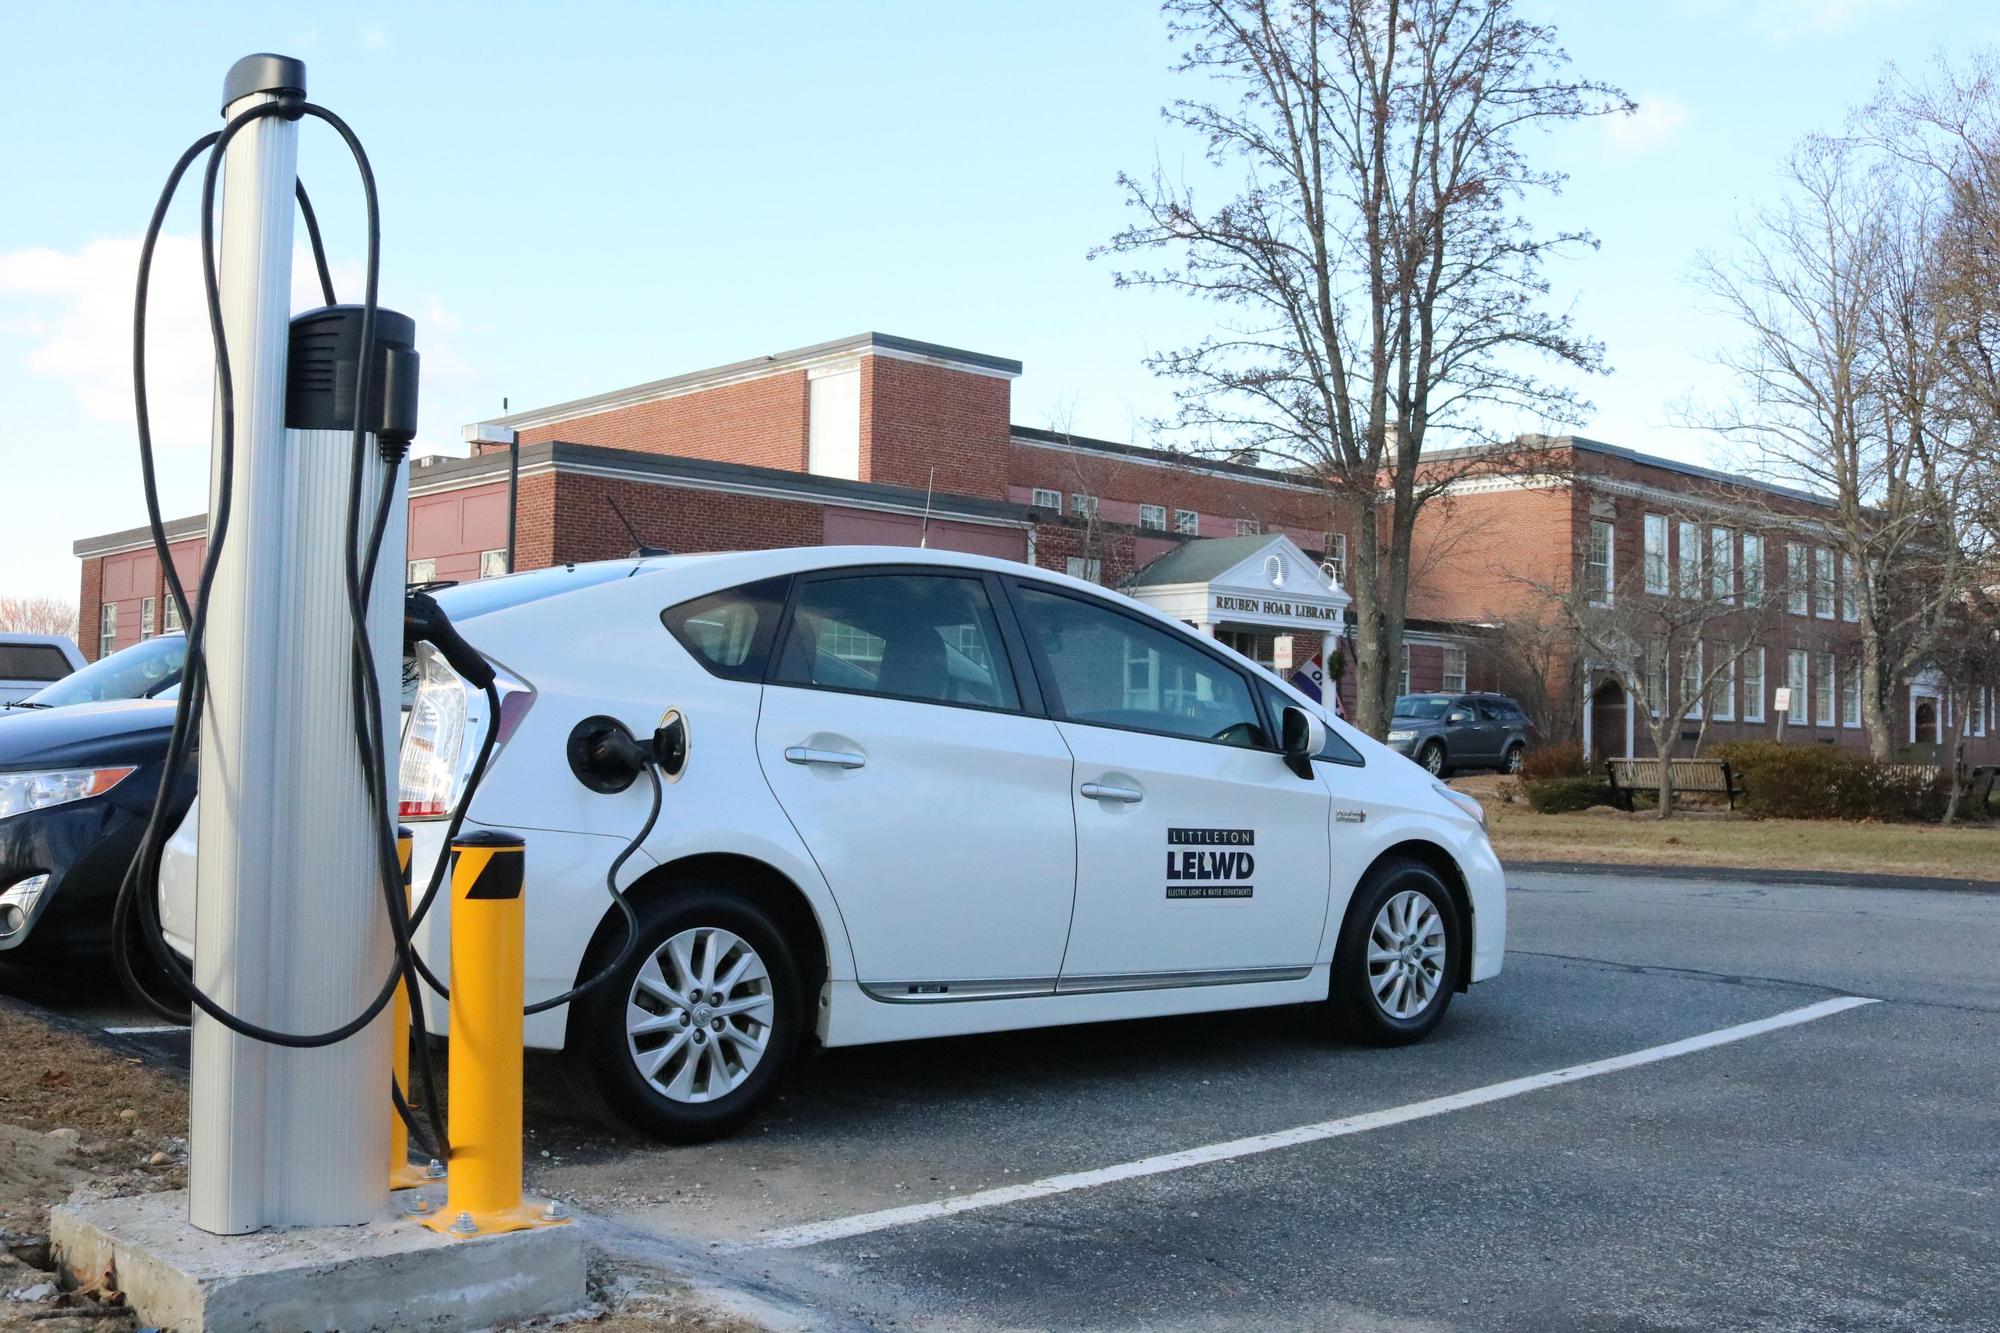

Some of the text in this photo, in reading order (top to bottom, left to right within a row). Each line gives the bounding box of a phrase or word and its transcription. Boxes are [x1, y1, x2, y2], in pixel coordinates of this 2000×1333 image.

[1216, 596, 1337, 620] REUBEN HOAR LIBRARY
[1173, 831, 1250, 843] LITTLETON
[1167, 851, 1255, 880] LELWD
[1168, 888, 1188, 897] ELECTRIC
[1189, 888, 1202, 896] LIGHT
[1208, 888, 1222, 896] WATER
